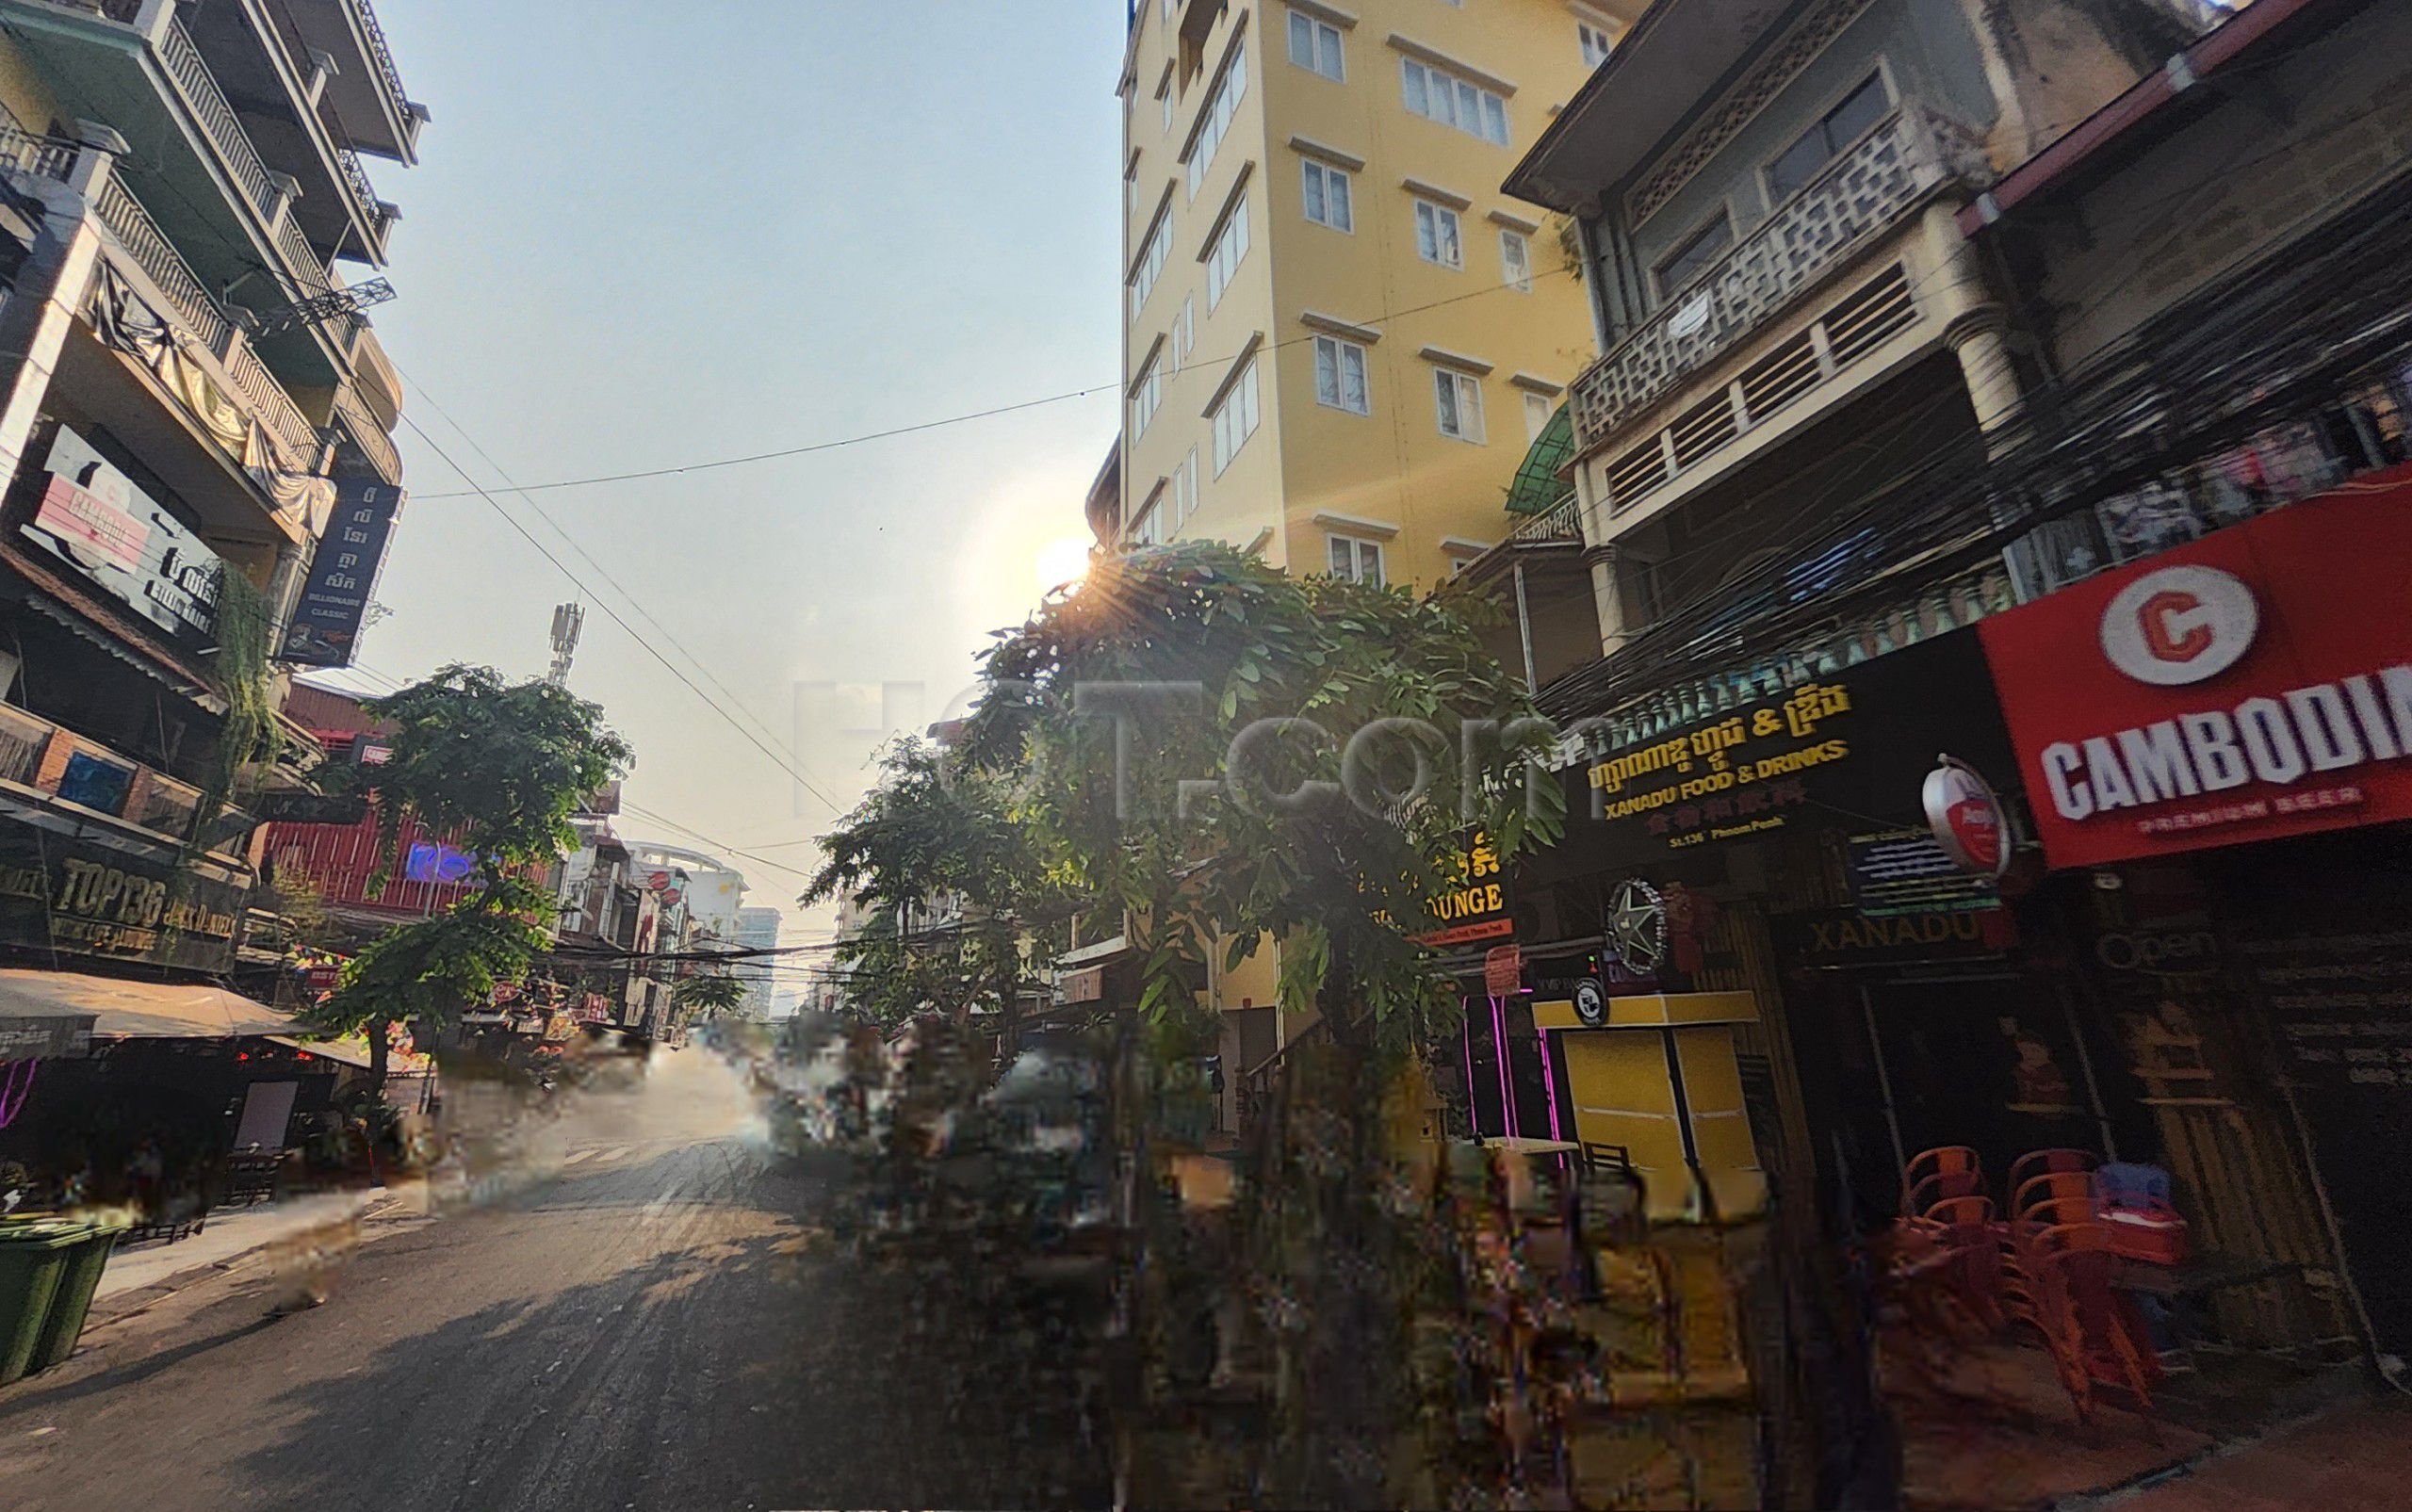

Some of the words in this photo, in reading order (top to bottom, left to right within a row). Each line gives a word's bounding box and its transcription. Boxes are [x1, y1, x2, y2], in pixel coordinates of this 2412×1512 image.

[308, 593, 361, 608] BILLIONAIRE
[311, 608, 350, 620] CLASSIC
[2137, 590, 2215, 663] C
[1752, 708, 1785, 737] &
[1605, 786, 1676, 821] XANADU
[1679, 771, 1736, 801] FOOD
[1737, 764, 1756, 784] &
[1756, 739, 1850, 779] DRINKS
[1809, 912, 1980, 953] XANADU
